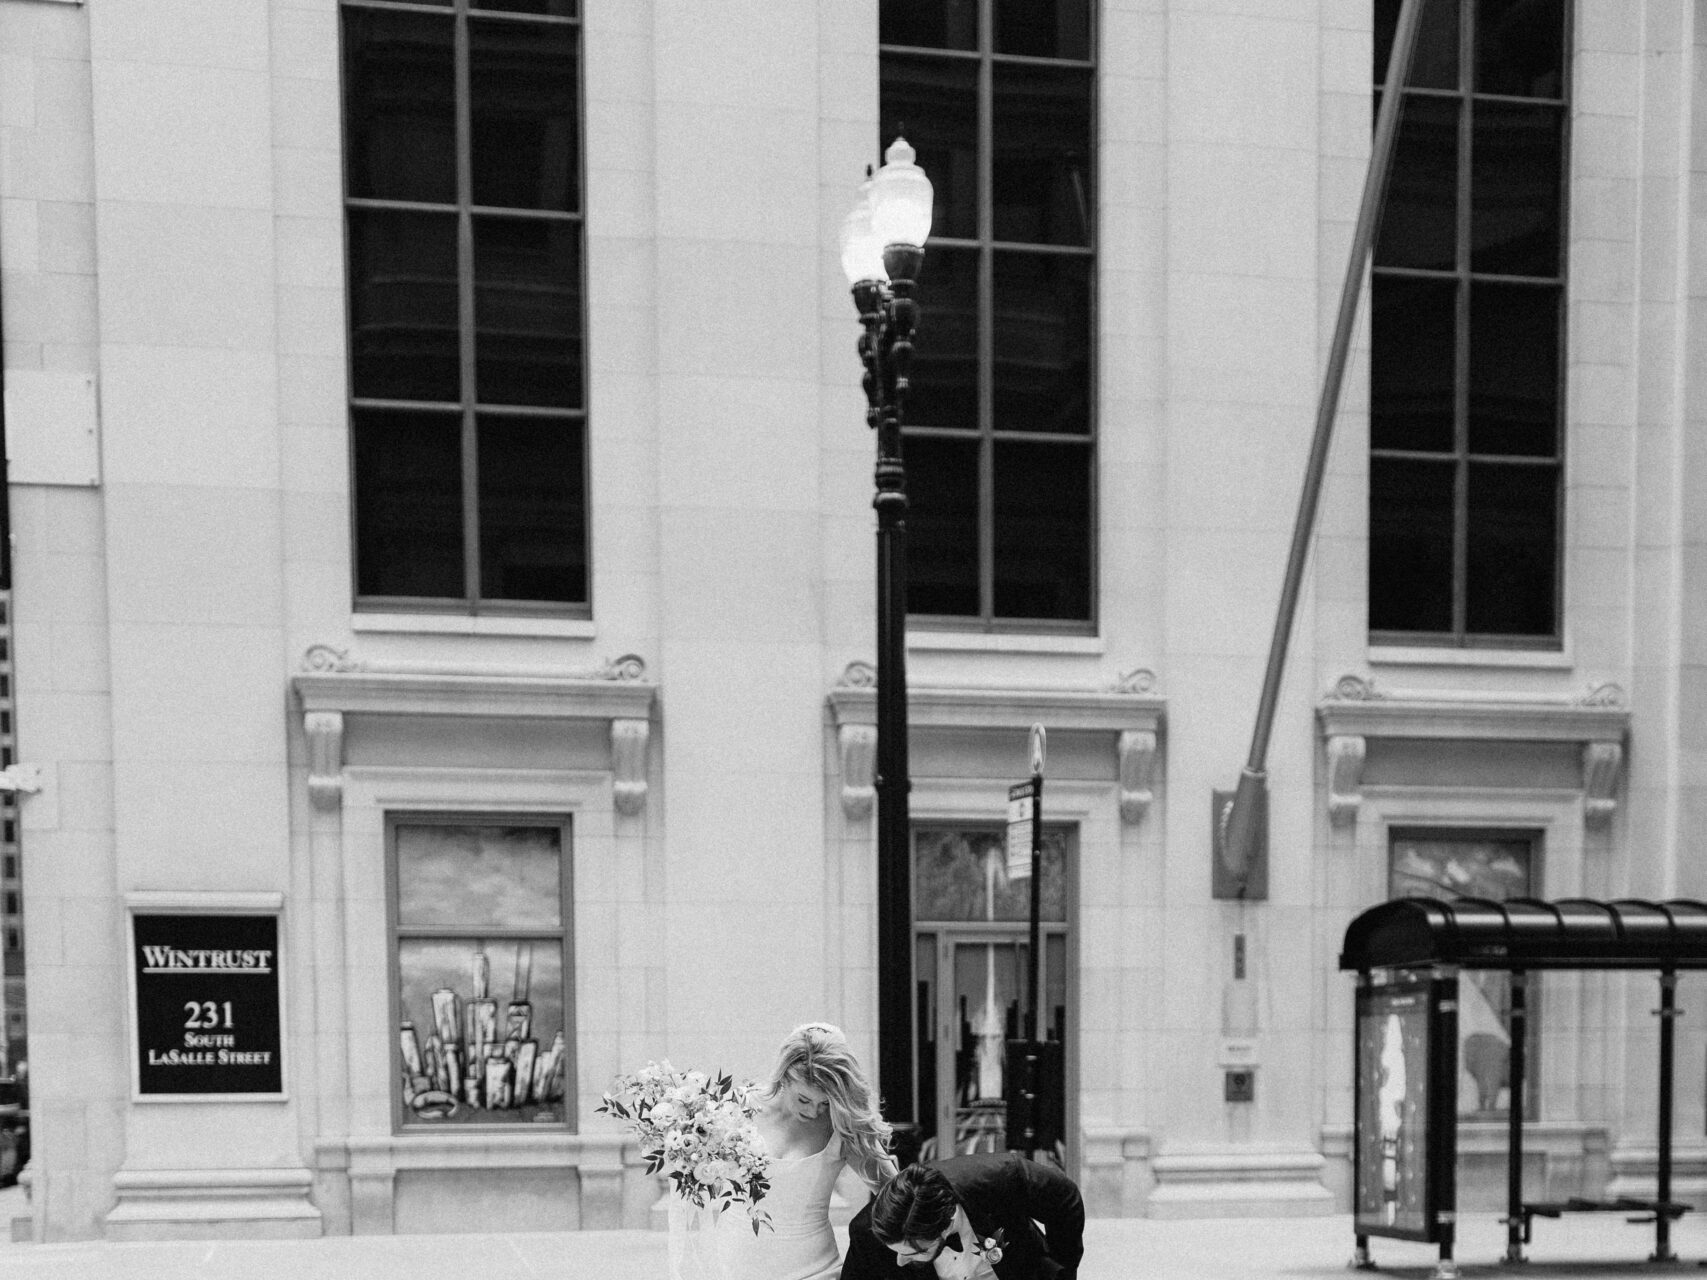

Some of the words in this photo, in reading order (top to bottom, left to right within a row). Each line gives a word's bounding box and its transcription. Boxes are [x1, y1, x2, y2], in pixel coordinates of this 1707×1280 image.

[142, 945, 272, 968] WINTRUST
[183, 1001, 234, 1029] 231
[184, 1032, 235, 1048] SOUTH
[217, 1049, 272, 1065] STREET
